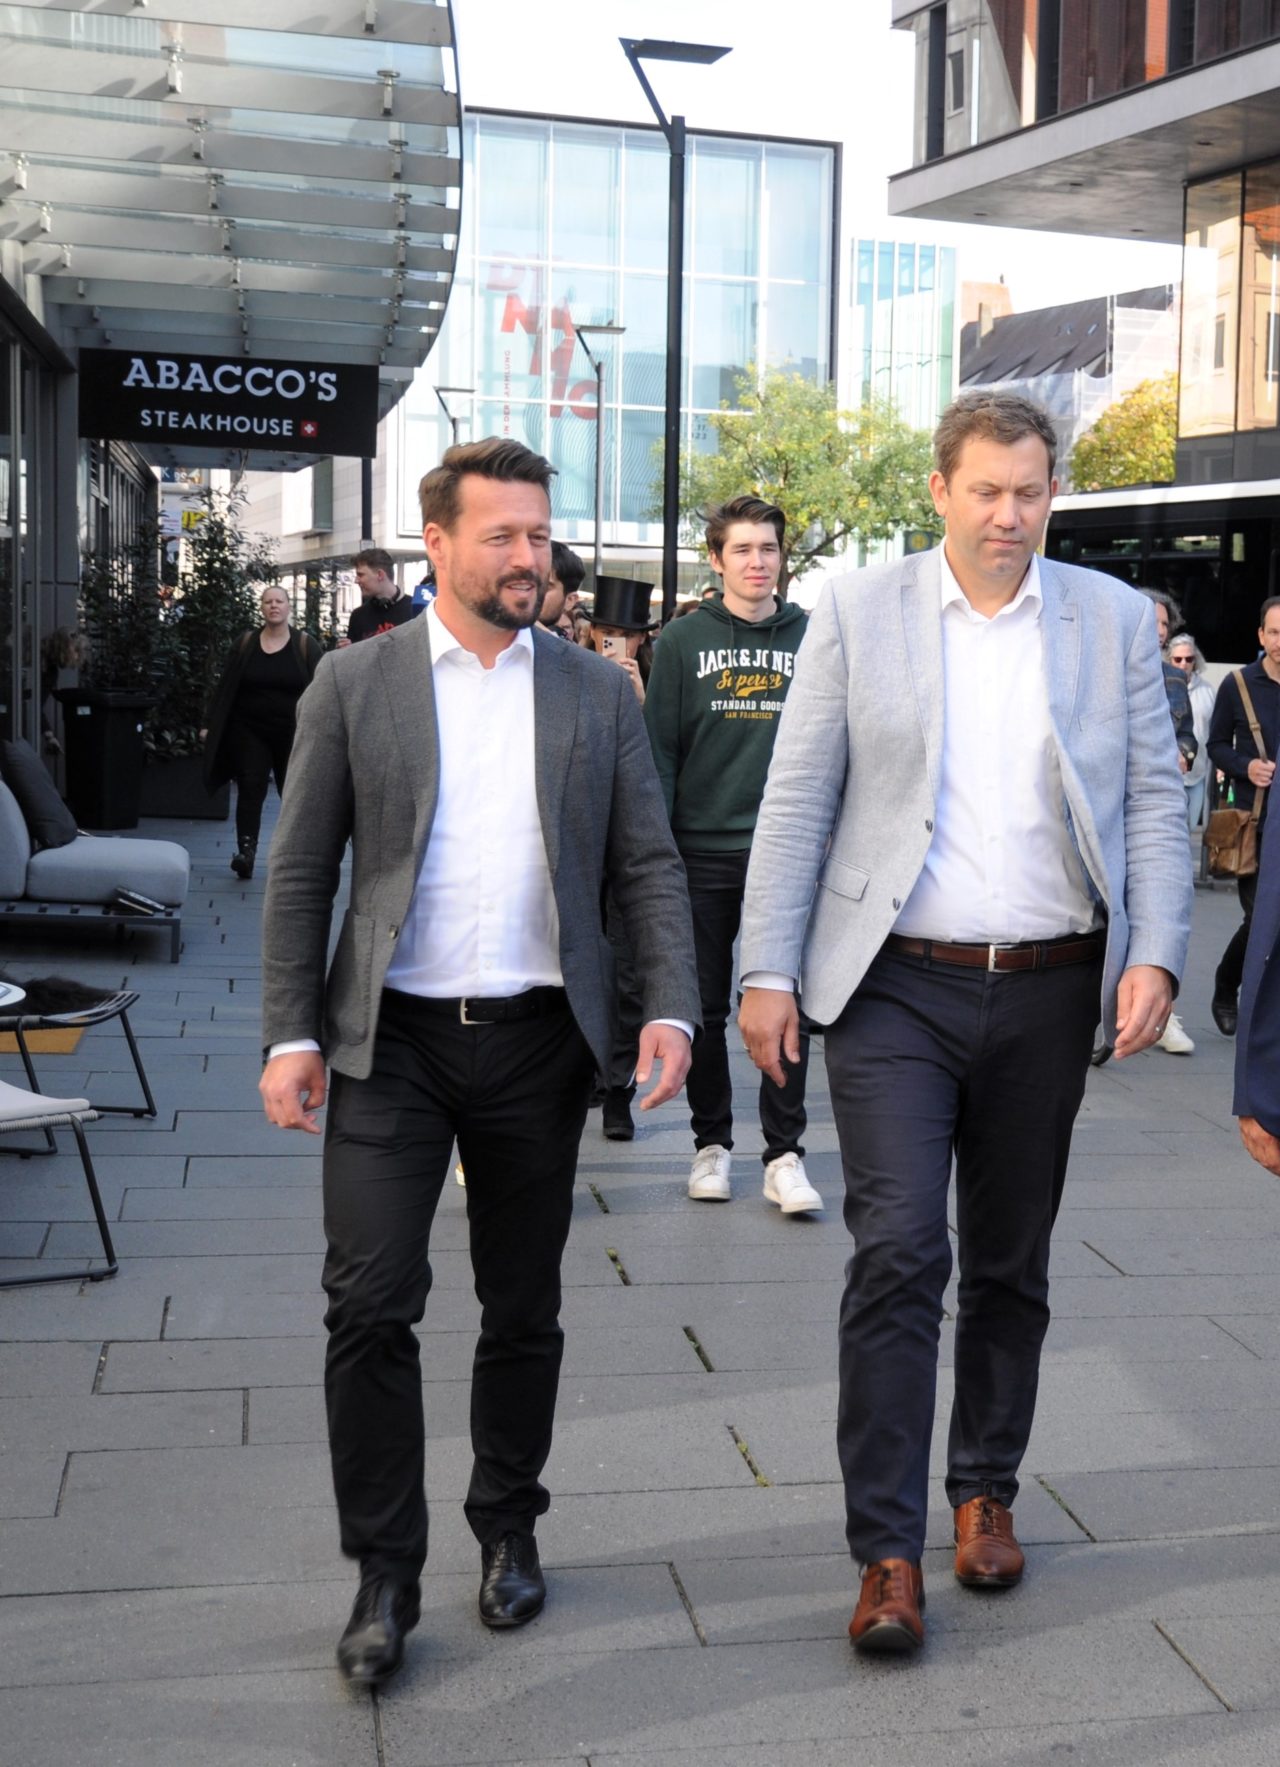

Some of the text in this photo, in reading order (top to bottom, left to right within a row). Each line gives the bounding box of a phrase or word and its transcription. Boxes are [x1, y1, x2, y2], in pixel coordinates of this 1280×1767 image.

[122, 357, 338, 402] ABACCO'S
[503, 350, 511, 400] AMMLUNG
[140, 409, 294, 436] STEAKHOUSE
[711, 700, 757, 711] STANDARD
[725, 711, 773, 719] SAN FRANCISCO
